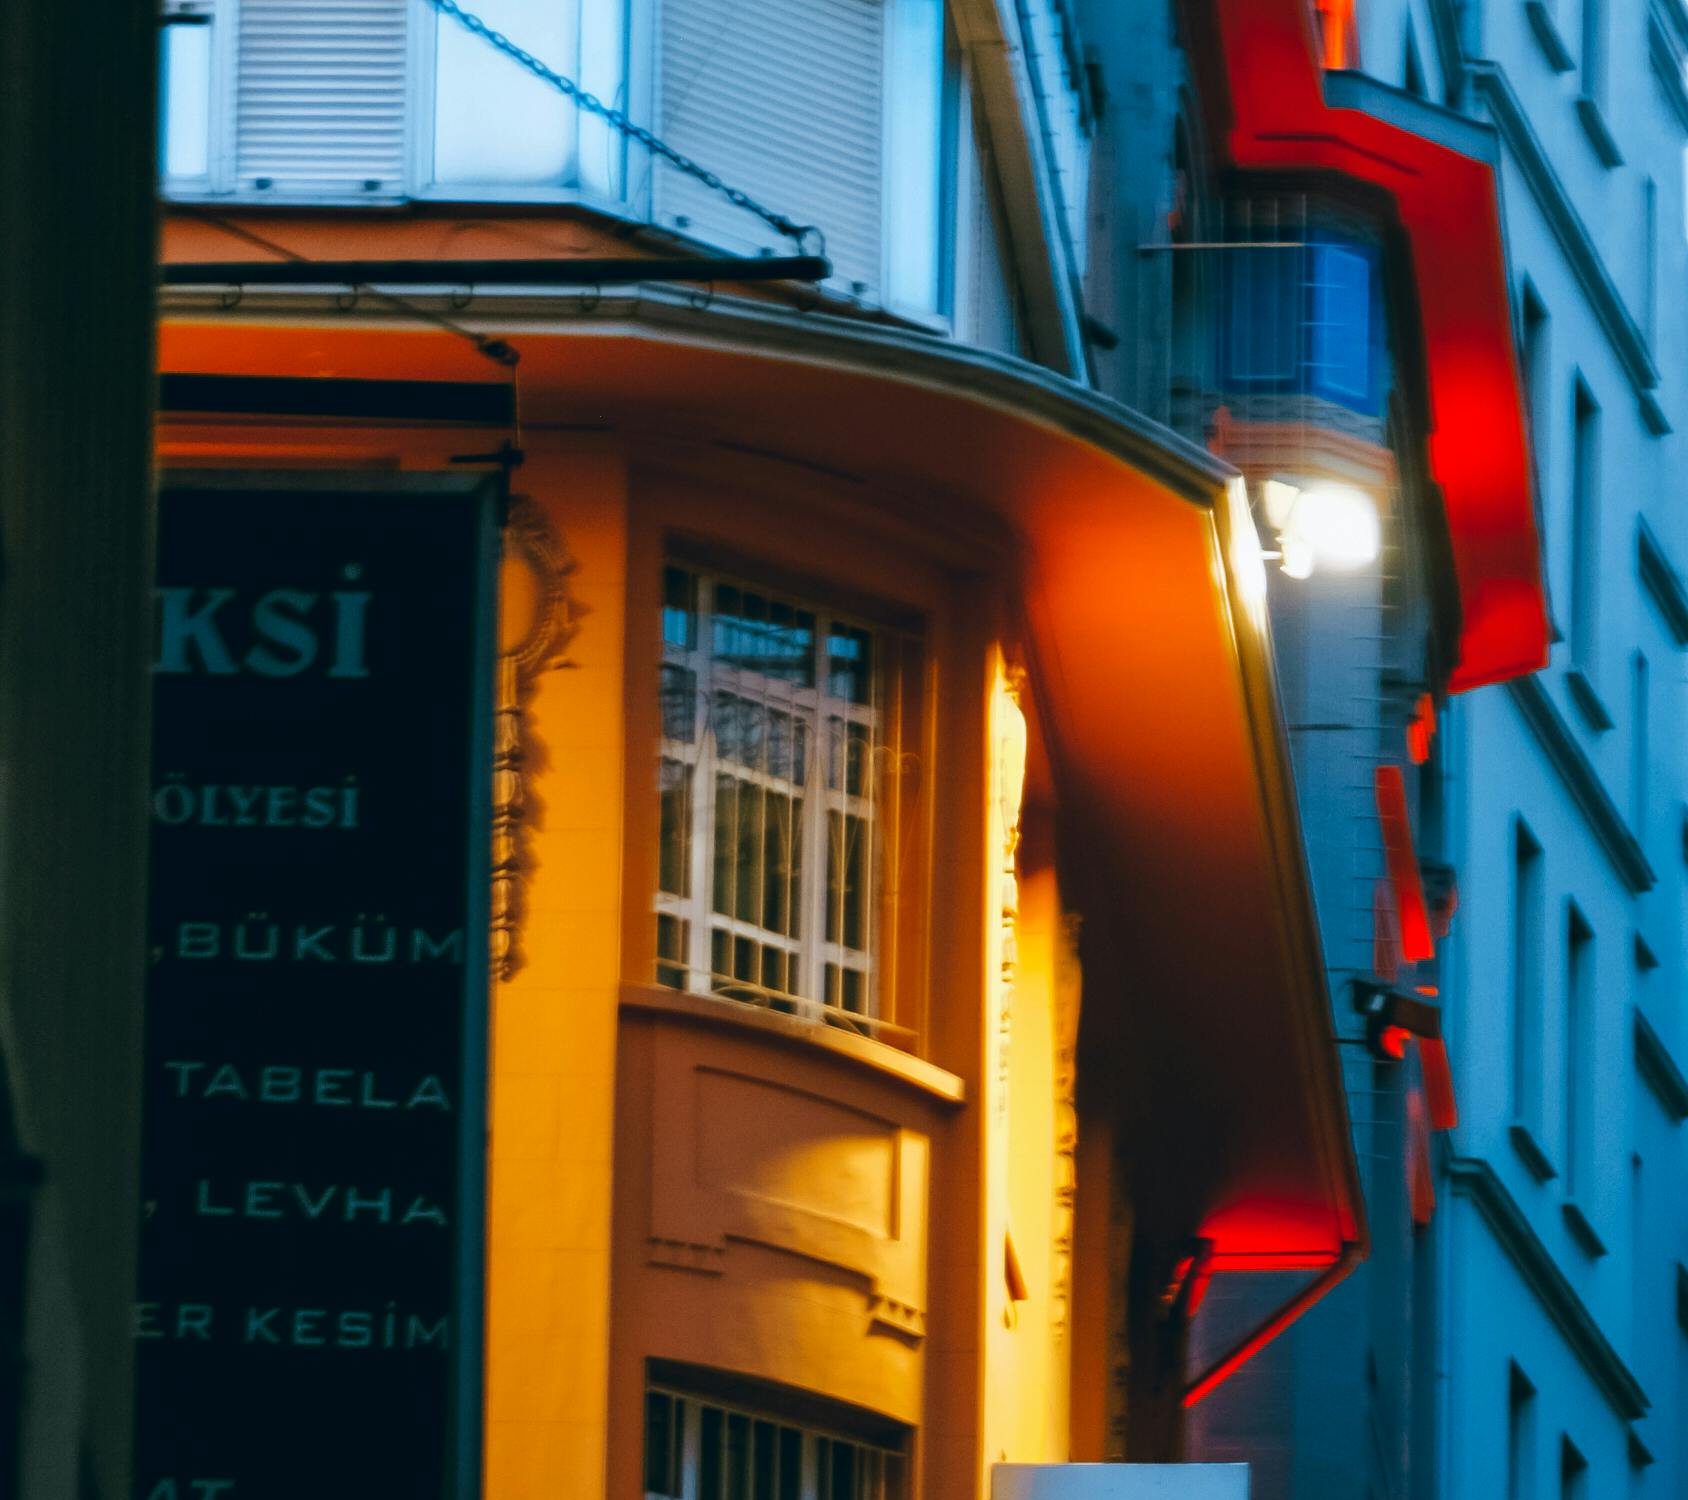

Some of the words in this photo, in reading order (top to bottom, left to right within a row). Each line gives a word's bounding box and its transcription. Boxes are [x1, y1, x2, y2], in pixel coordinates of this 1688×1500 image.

[152, 562, 374, 680] KSİ
[154, 770, 362, 828] ÖLYESİ
[177, 912, 464, 964] BÜKÜM
[163, 1060, 450, 1111] TABELA
[195, 1178, 449, 1226] LEVHA
[134, 1302, 214, 1342] ER
[245, 1299, 450, 1350] KESİM
